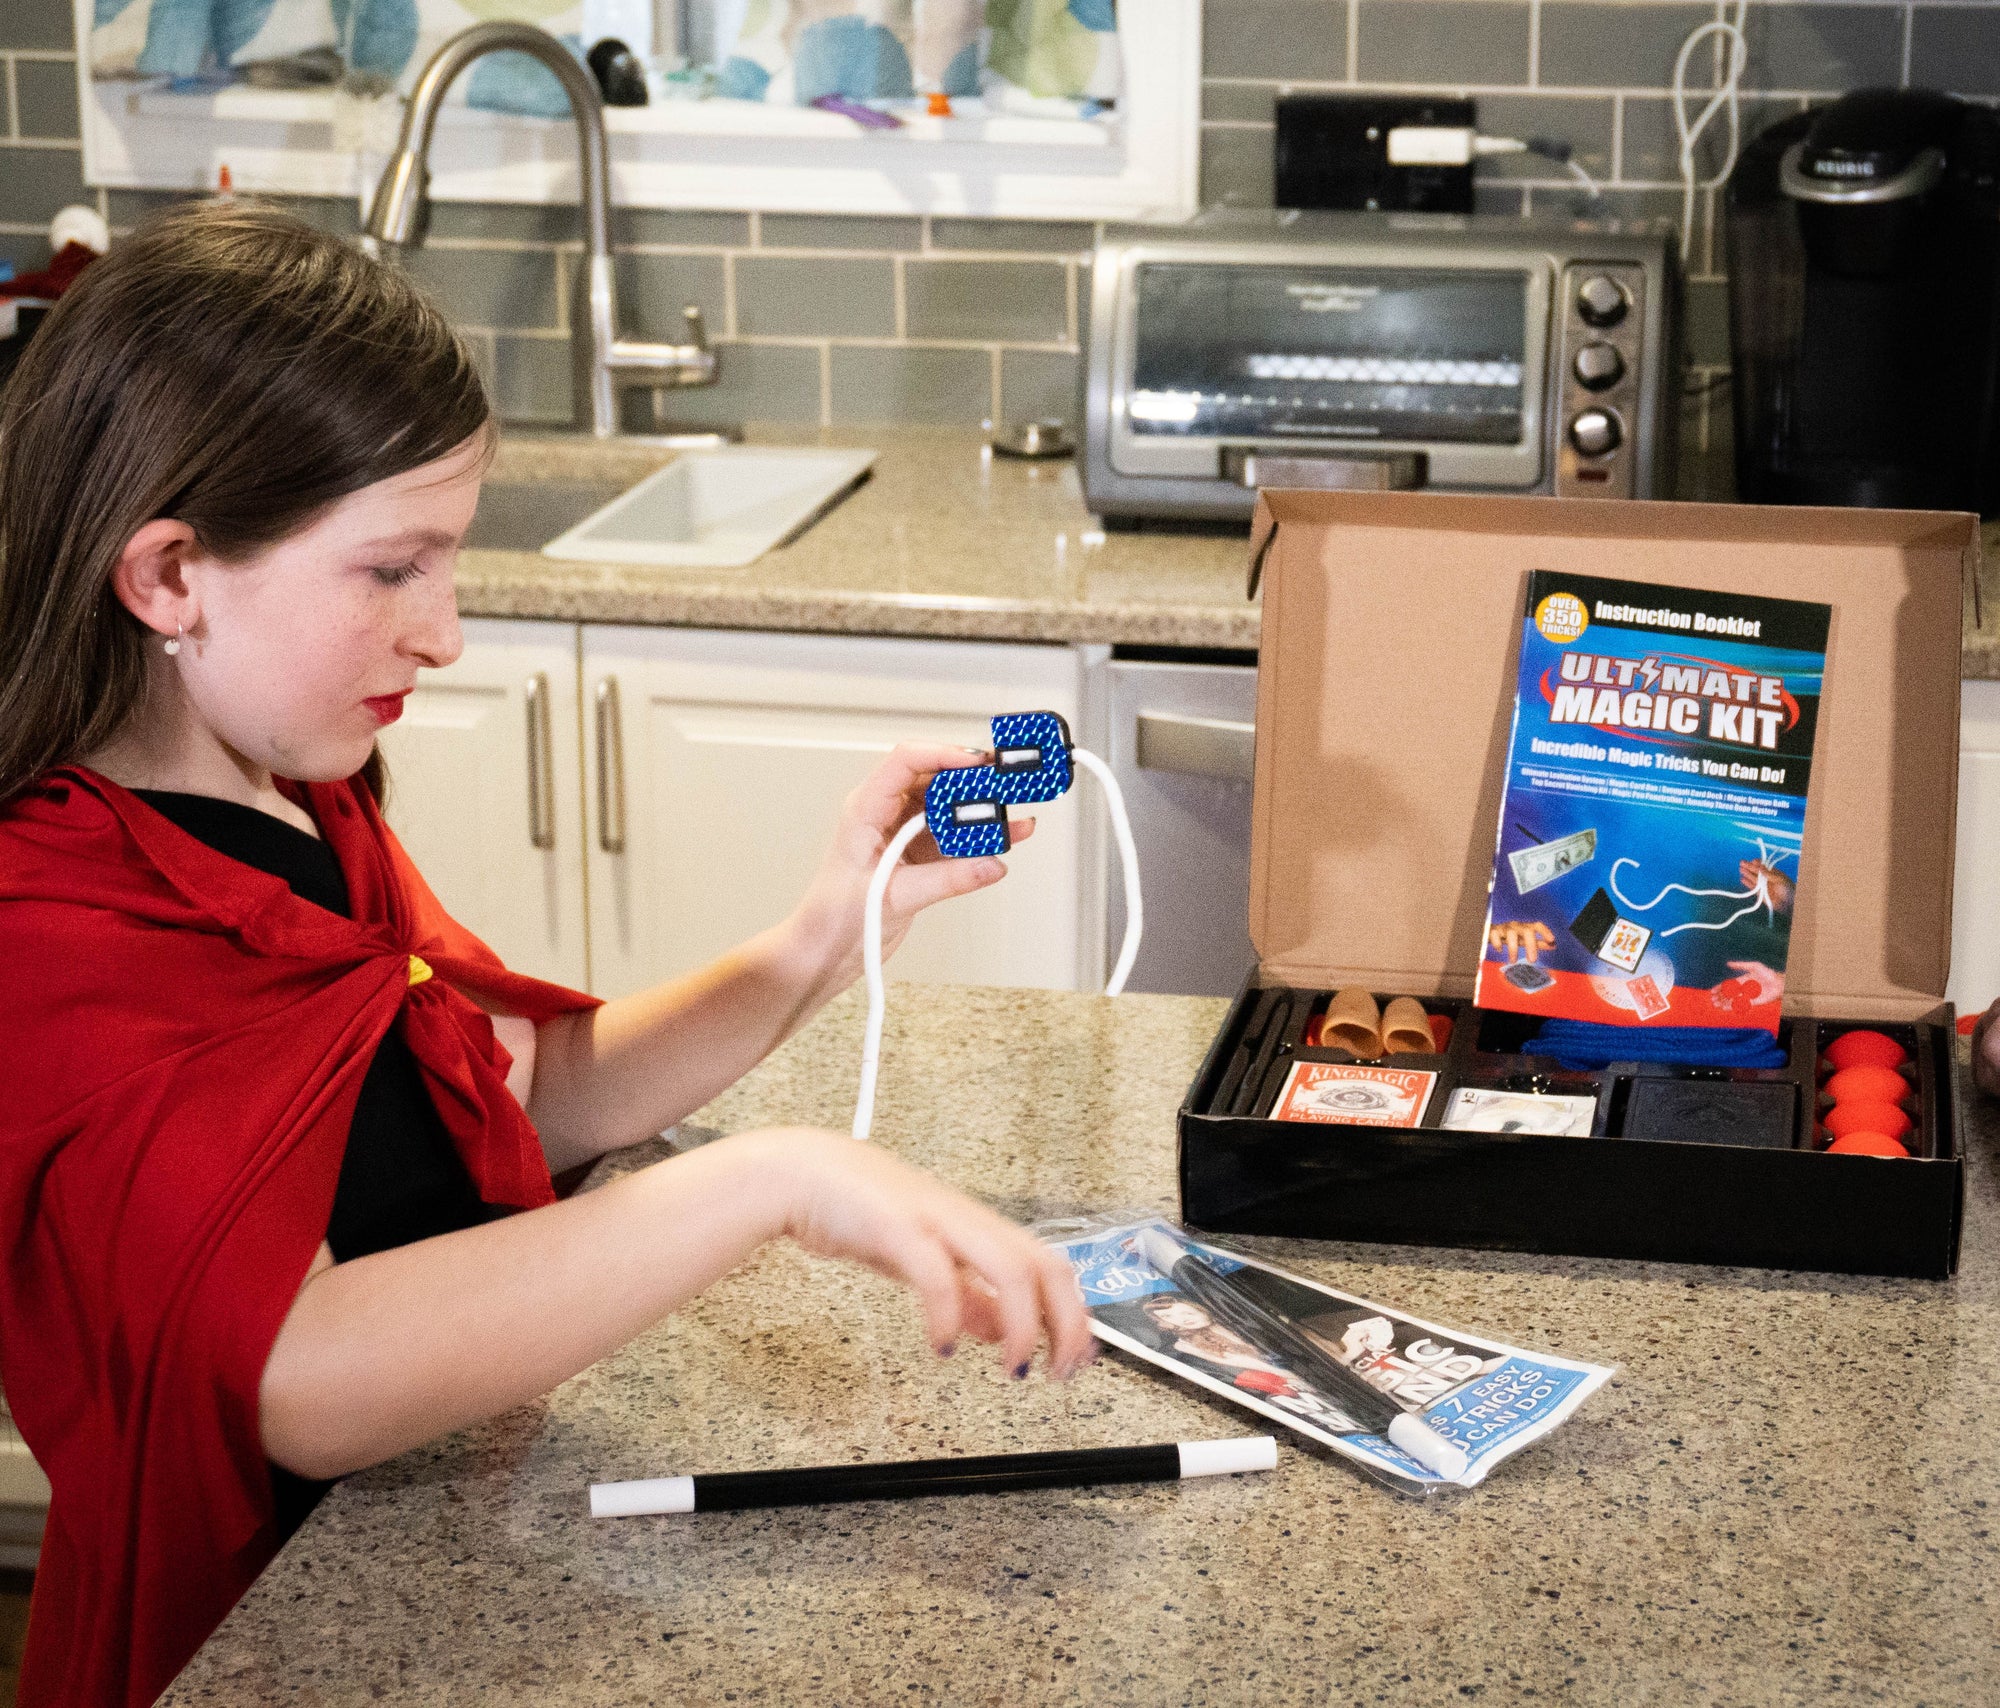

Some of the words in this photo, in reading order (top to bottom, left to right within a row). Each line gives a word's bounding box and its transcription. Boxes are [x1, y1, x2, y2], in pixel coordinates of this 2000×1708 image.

[1814, 160, 1875, 176] KEURIG
[1543, 607, 1582, 627] 350
[1549, 596, 1580, 610] OVER
[1595, 600, 1693, 629] Instruction
[1693, 612, 1762, 638] Booklet
[1542, 624, 1581, 638] TRICKS!
[1560, 652, 1783, 708] ULTIMATE
[1550, 684, 1701, 735] MAGIC
[1709, 702, 1784, 750] KIT
[1531, 737, 1606, 762] Incredible
[1608, 747, 1653, 768] Magic
[1655, 752, 1699, 774] Tricks
[1701, 759, 1728, 777] You
[1730, 762, 1759, 780] Can
[1760, 766, 1786, 784] Do!
[1307, 1066, 1419, 1091] KINGMAGIC
[1289, 1112, 1351, 1124] PLAYING
[1355, 1117, 1405, 1128] CARDS
[1443, 1397, 1465, 1414] 7
[1472, 1365, 1521, 1398] EASY
[1453, 1369, 1544, 1426] TRICKS
[1465, 1411, 1519, 1441] CAN
[1515, 1379, 1561, 1411] DO!
